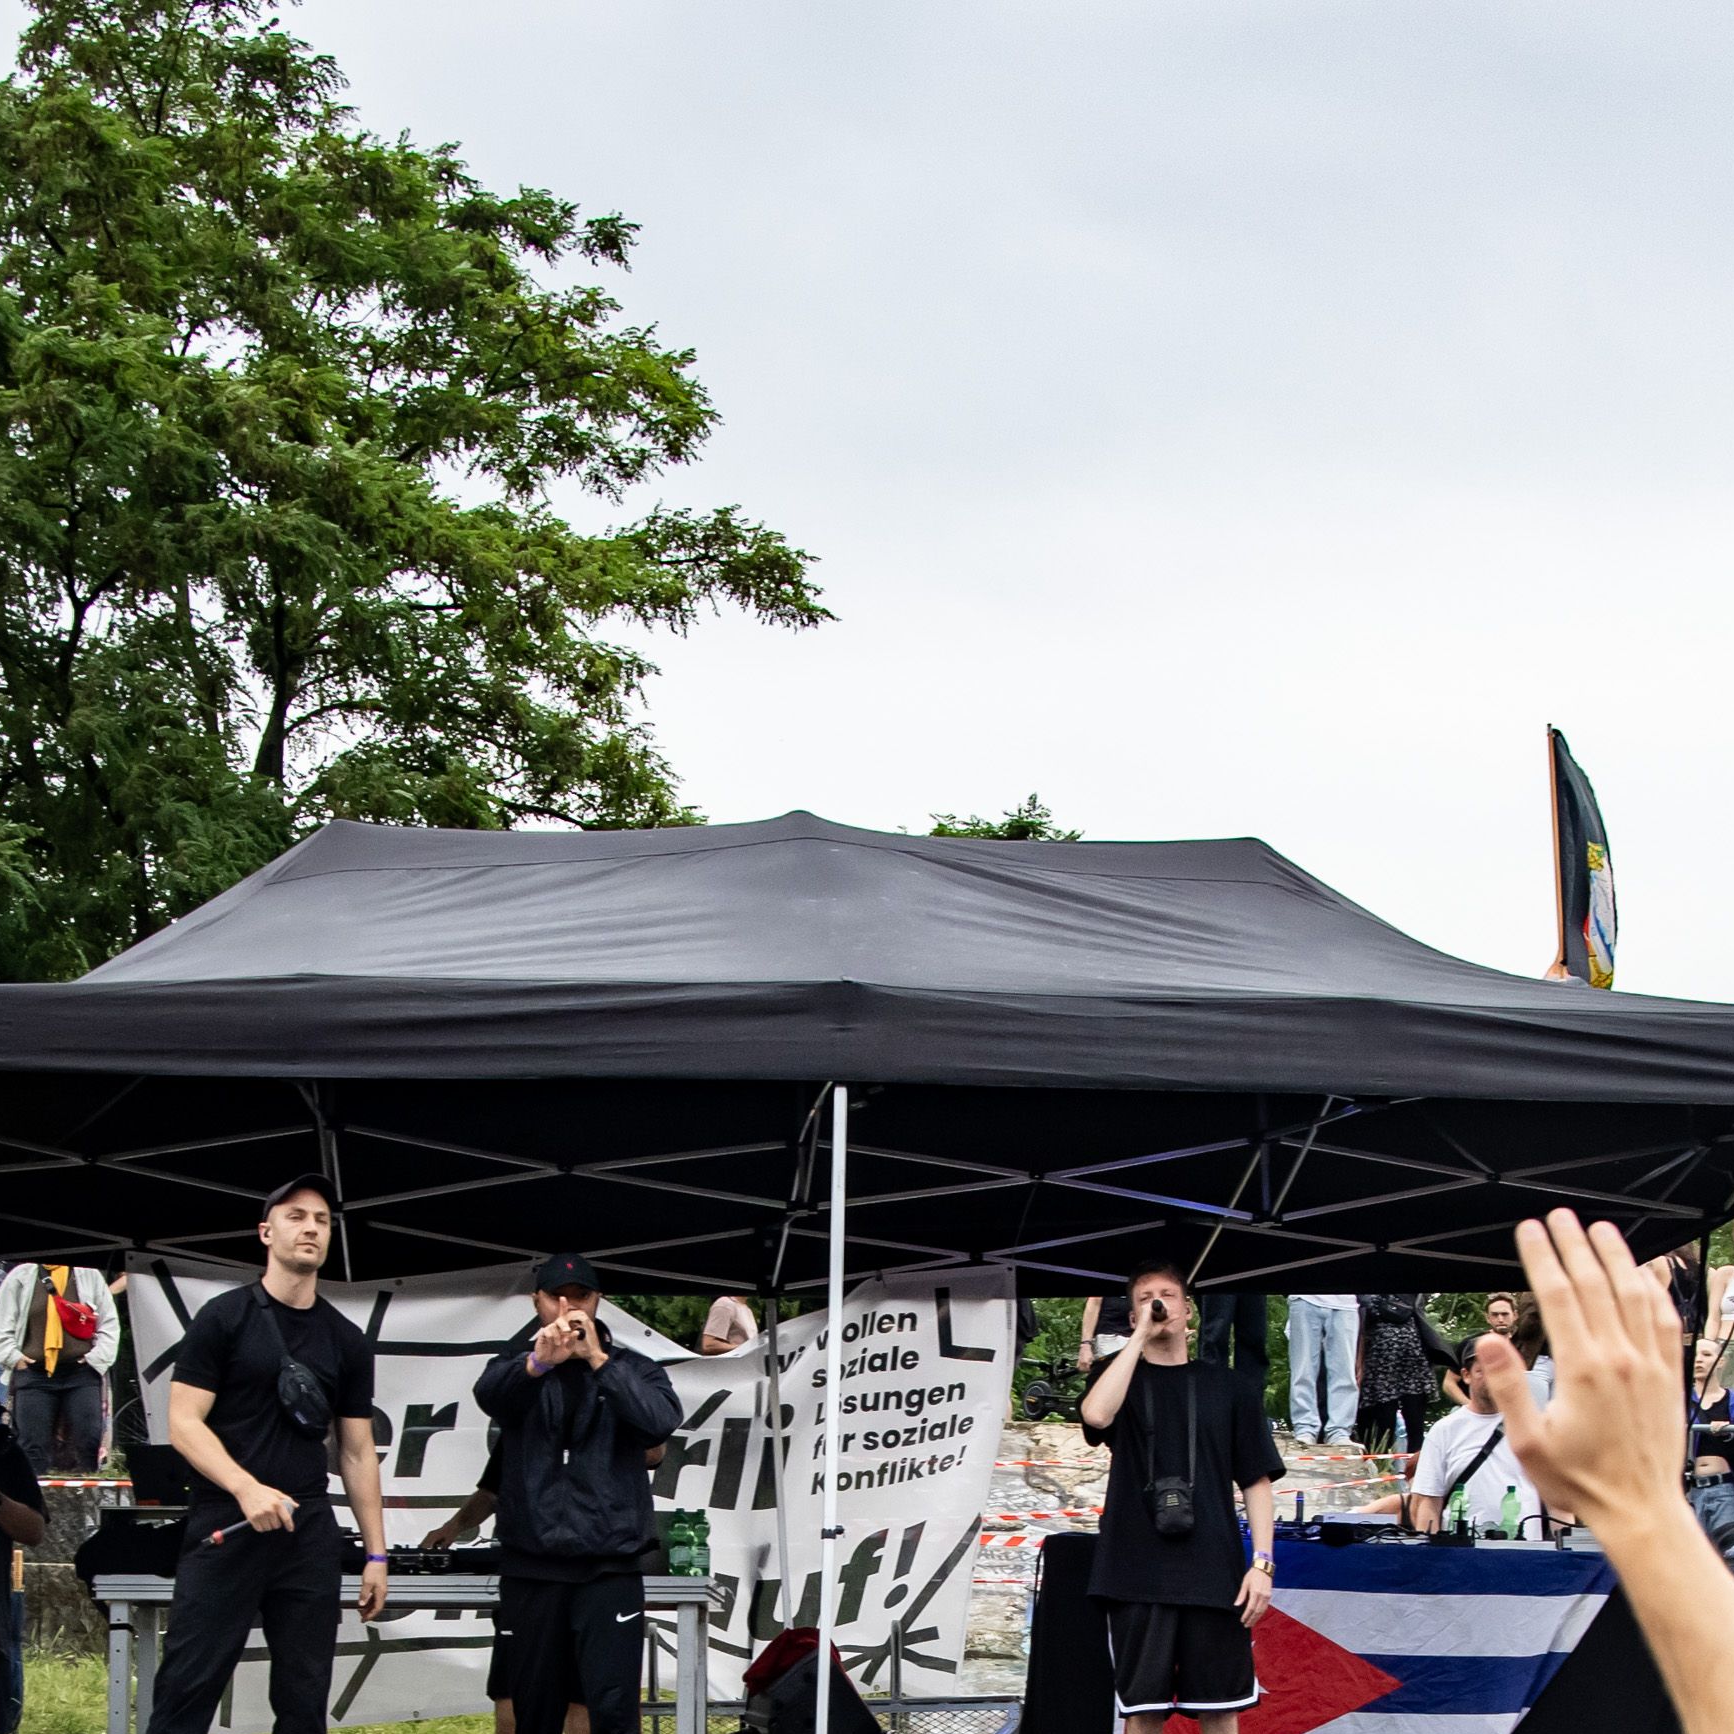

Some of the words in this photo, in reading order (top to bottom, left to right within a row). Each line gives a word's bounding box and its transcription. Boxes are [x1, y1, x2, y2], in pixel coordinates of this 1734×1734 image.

[811, 1345, 920, 1388] sziale
[814, 1382, 966, 1426] Lsungen
[812, 1436, 856, 1461] fr
[862, 1413, 974, 1451] soziale
[810, 1445, 967, 1496] Konflikte!
